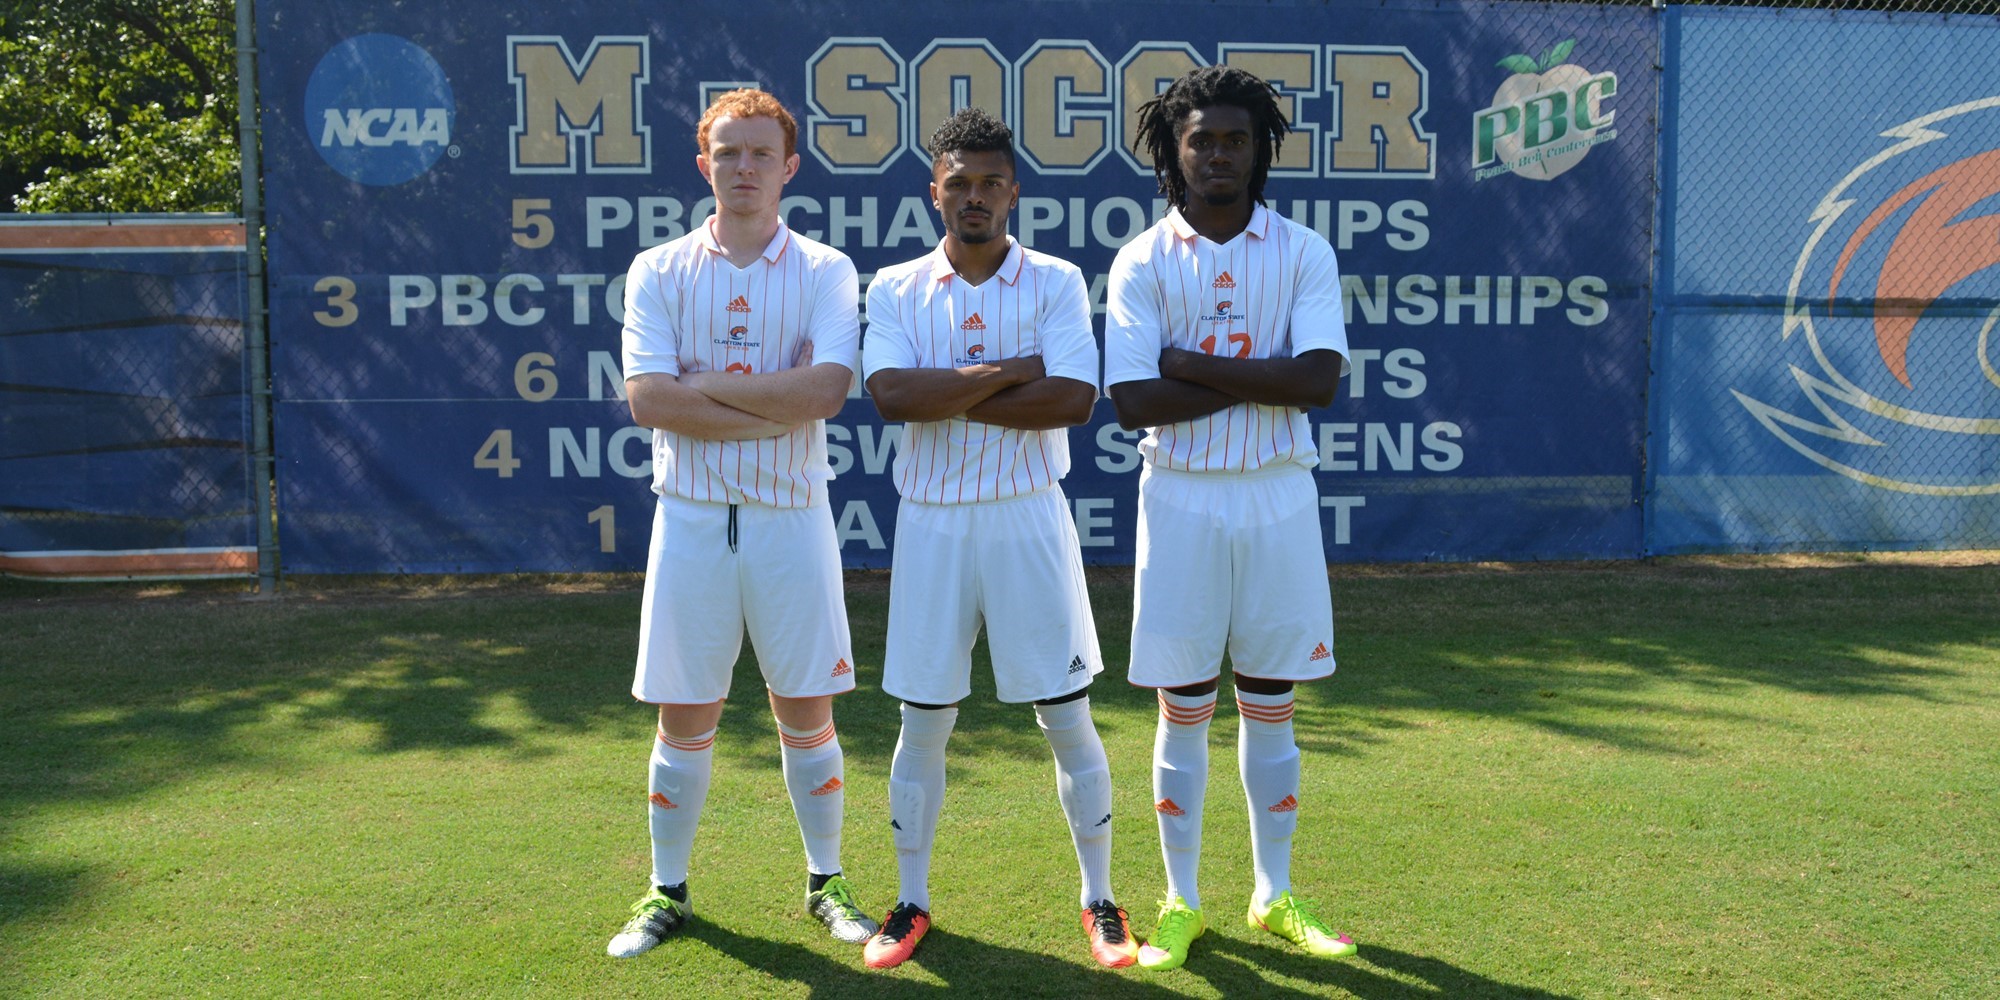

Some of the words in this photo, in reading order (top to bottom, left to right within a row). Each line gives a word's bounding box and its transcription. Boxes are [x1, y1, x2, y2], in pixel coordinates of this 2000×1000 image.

[320, 108, 450, 146] NCAA
[507, 35, 651, 174] M
[1472, 70, 1617, 169] PBC
[512, 198, 555, 249] 5
[313, 276, 359, 327] 3
[388, 273, 546, 327] PBC
[514, 352, 559, 402] 6
[473, 429, 521, 478] 4
[587, 505, 616, 553] 1
[831, 667, 852, 677] adidas
[1309, 651, 1331, 661] adidas
[1268, 803, 1298, 813] adida
